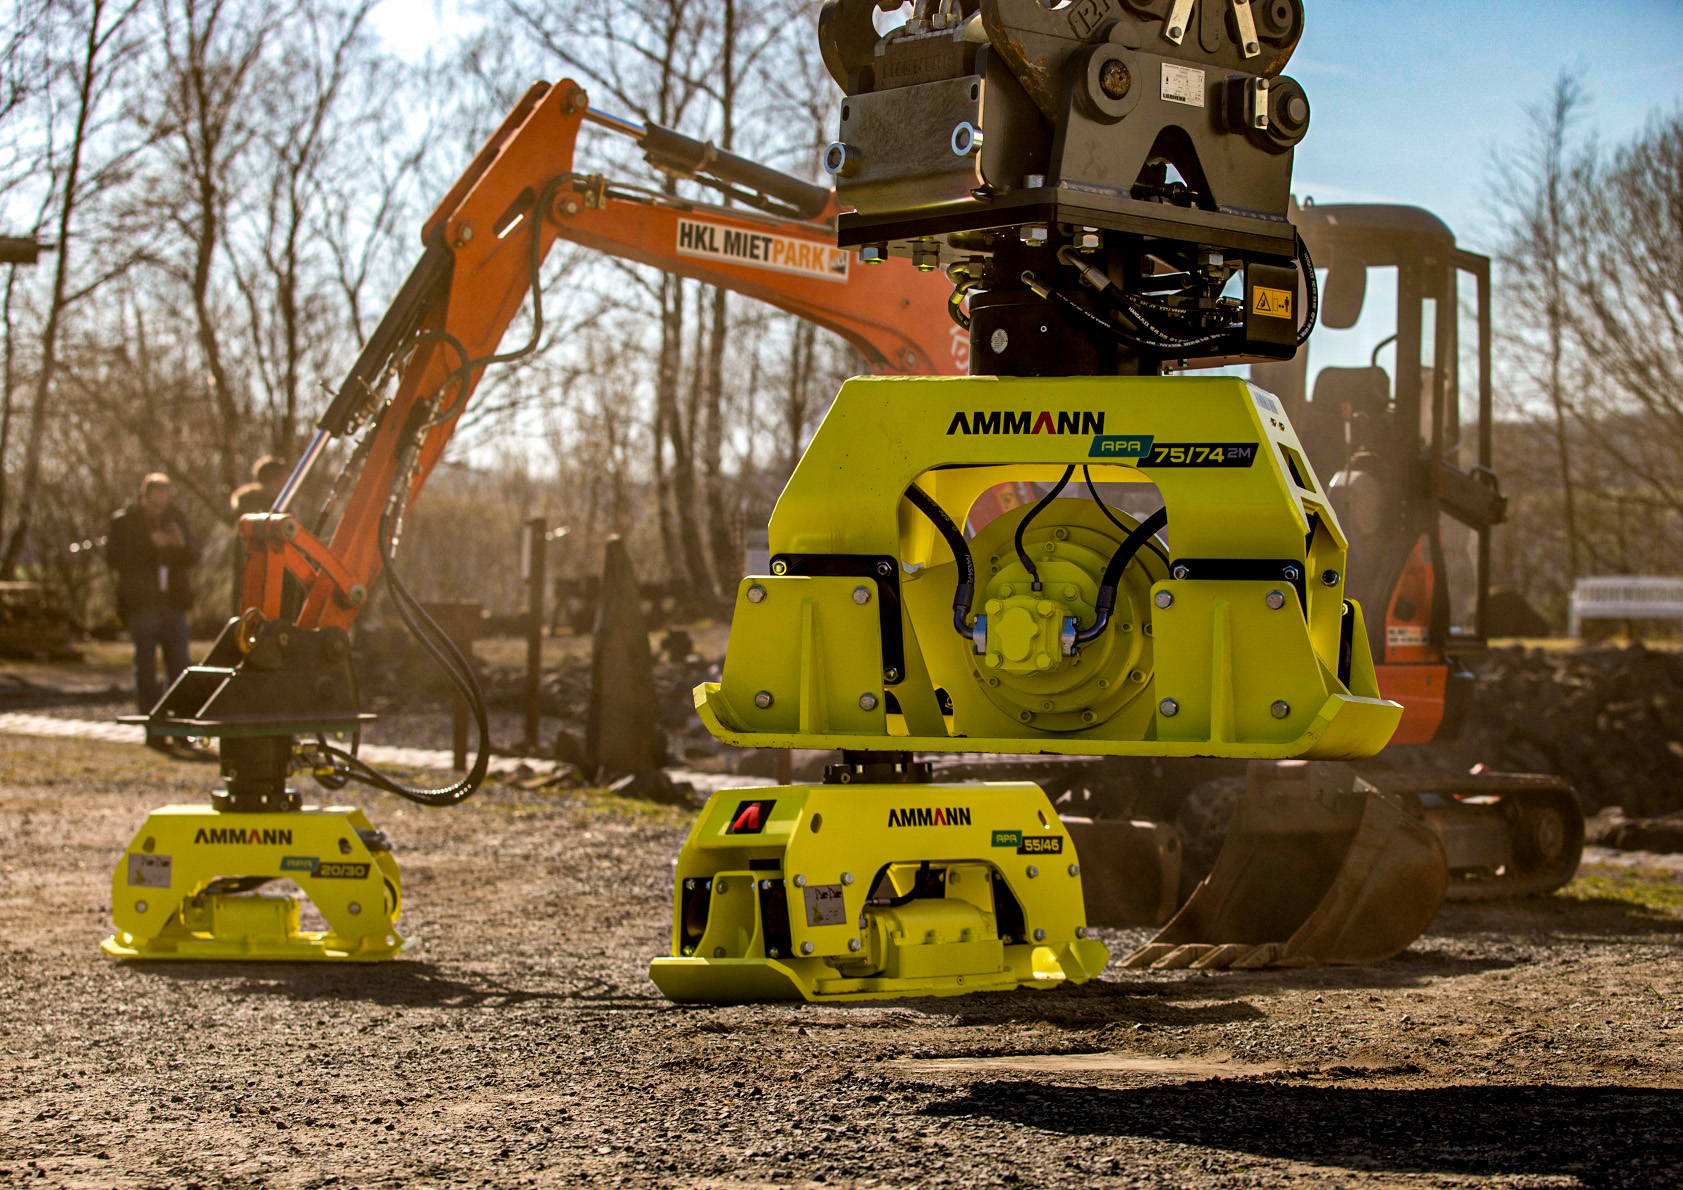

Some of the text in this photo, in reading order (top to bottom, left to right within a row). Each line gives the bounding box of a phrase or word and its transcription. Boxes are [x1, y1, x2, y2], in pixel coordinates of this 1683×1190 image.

[680, 222, 719, 252] HKL
[946, 411, 1105, 435] AMMANN
[1101, 441, 1141, 452] APA
[1154, 447, 1225, 463] 75/74
[888, 807, 971, 827] AMMANN
[194, 829, 293, 845] AMMANN
[996, 834, 1060, 852] APA 55/46
[321, 864, 366, 877] 20/30
